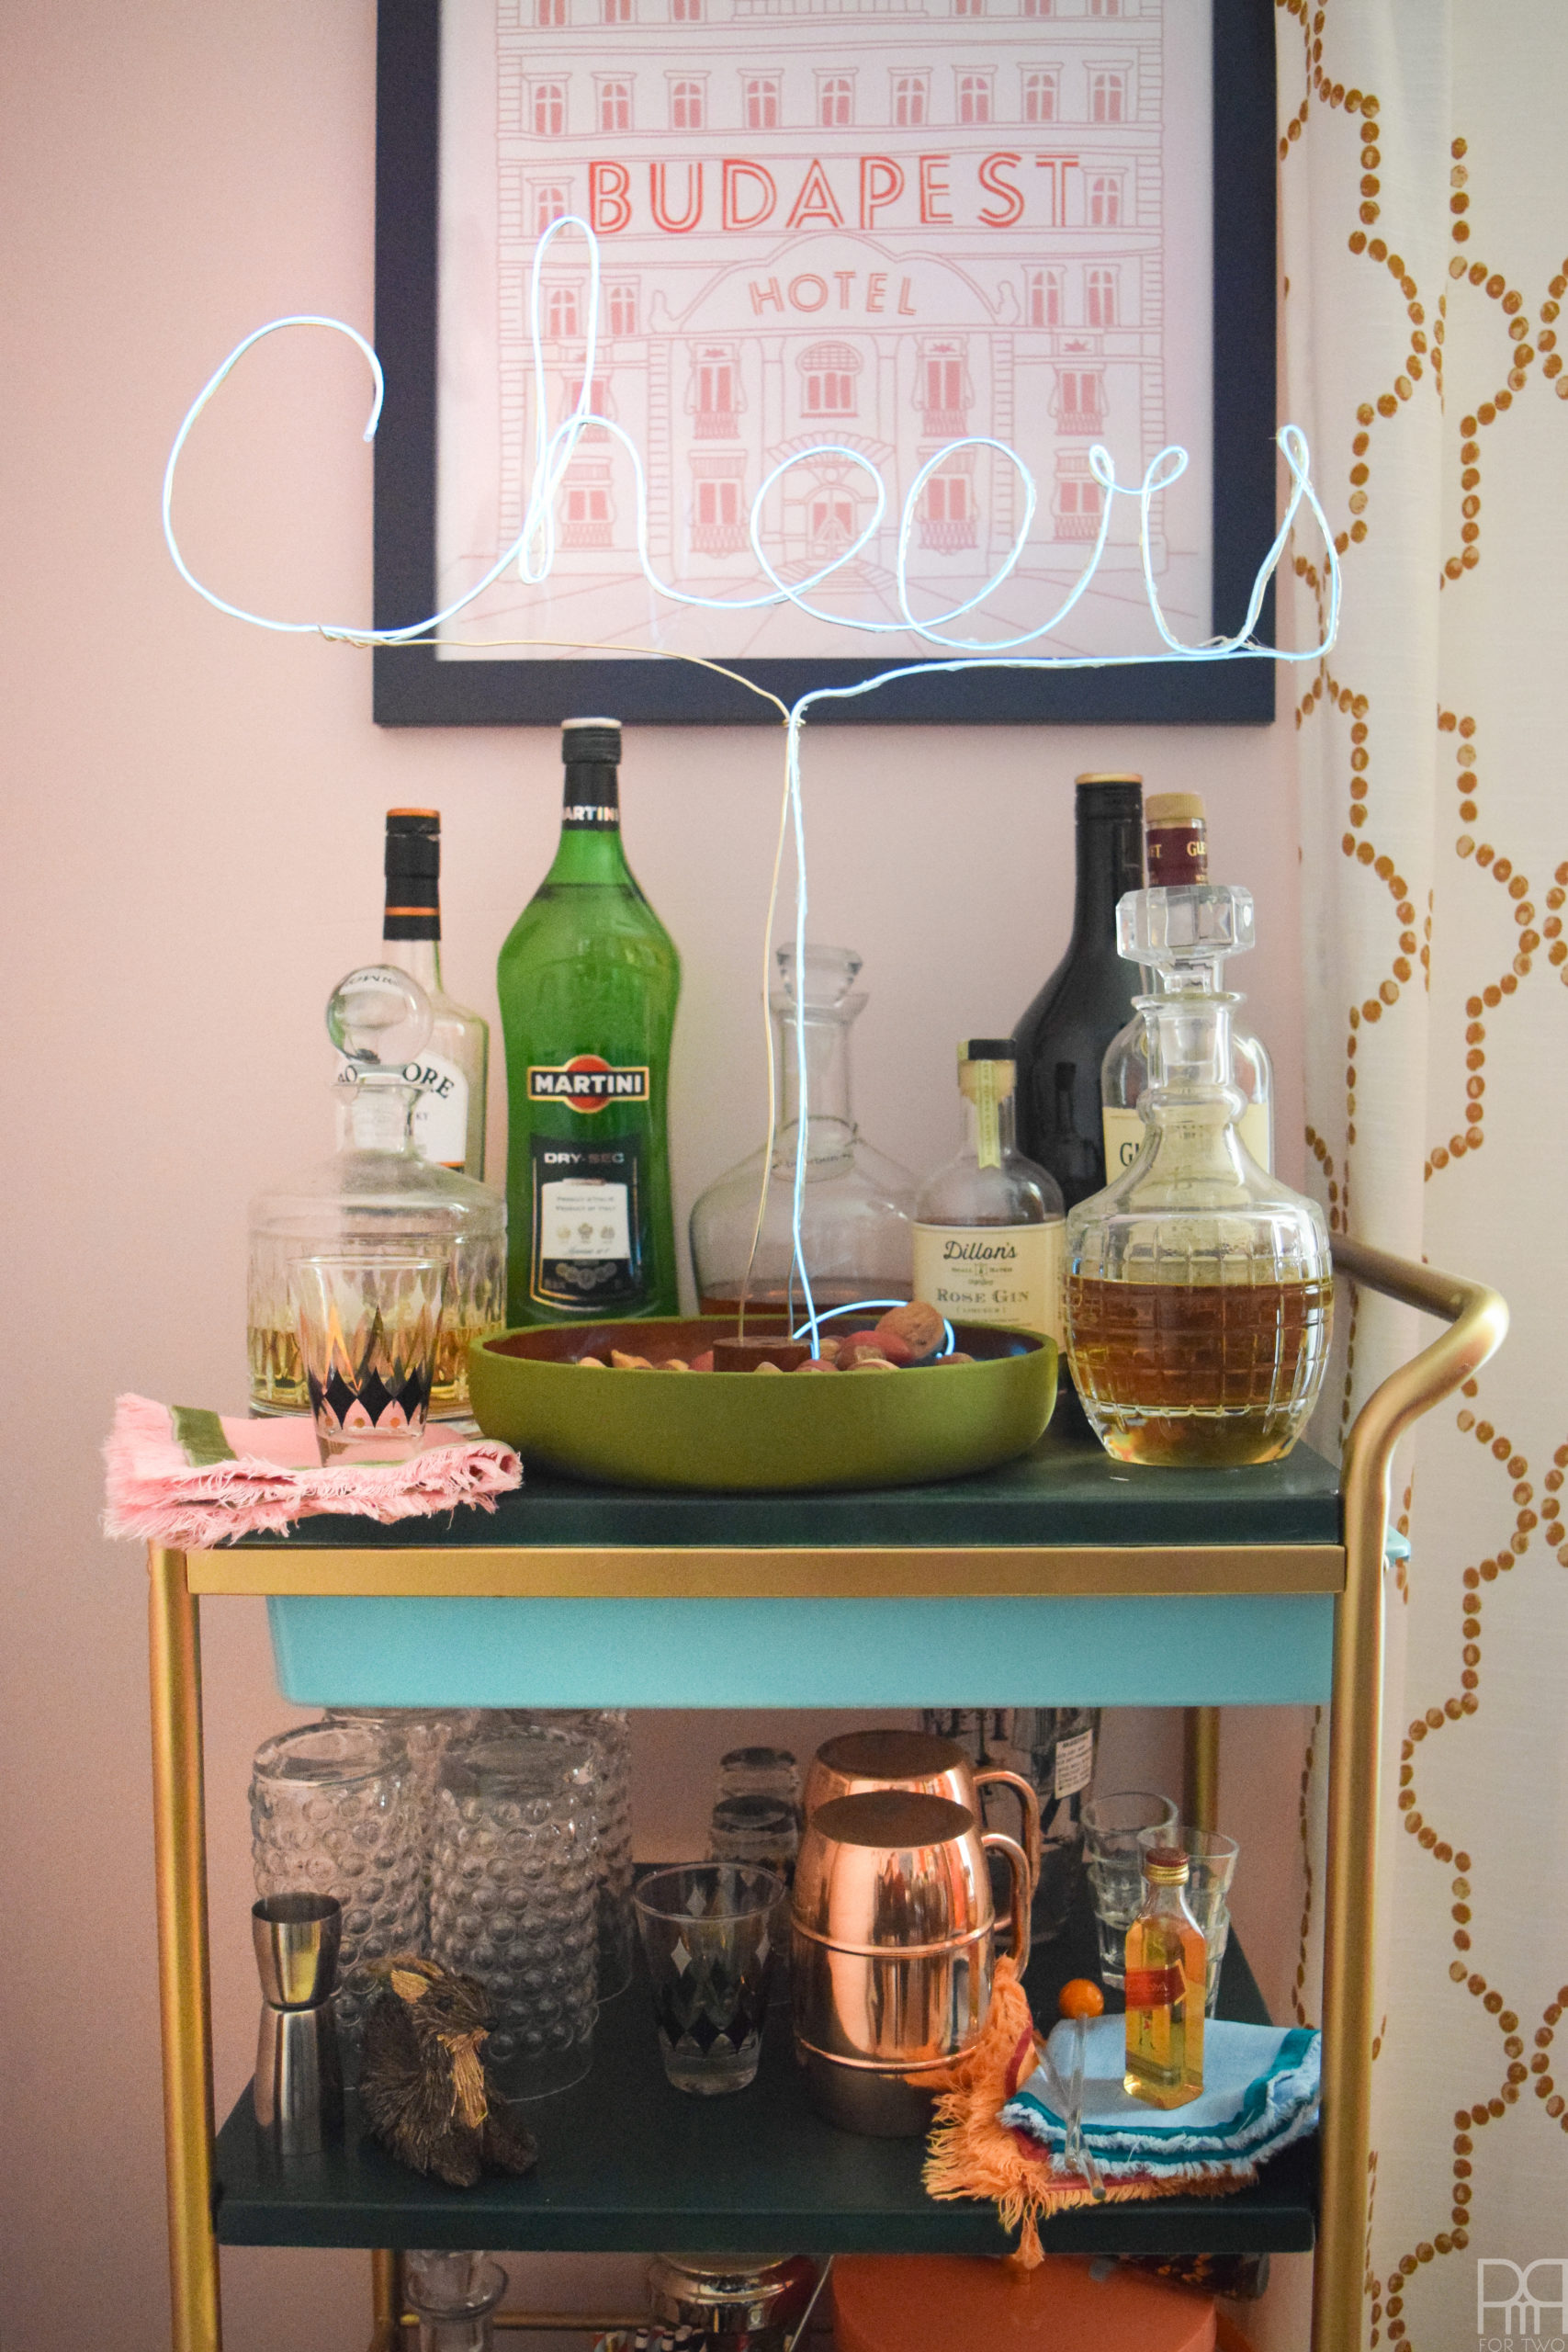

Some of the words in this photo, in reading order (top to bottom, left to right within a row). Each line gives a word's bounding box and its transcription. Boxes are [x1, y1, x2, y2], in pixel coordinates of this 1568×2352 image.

[588, 152, 1079, 233] BUDAPEST
[748, 271, 917, 315] HOTEL
[535, 1074, 642, 1094] MARTINI
[943, 1240, 1019, 1261] Dillon's
[937, 1288, 986, 1303] ROSE
[992, 1289, 1029, 1303] GIN
